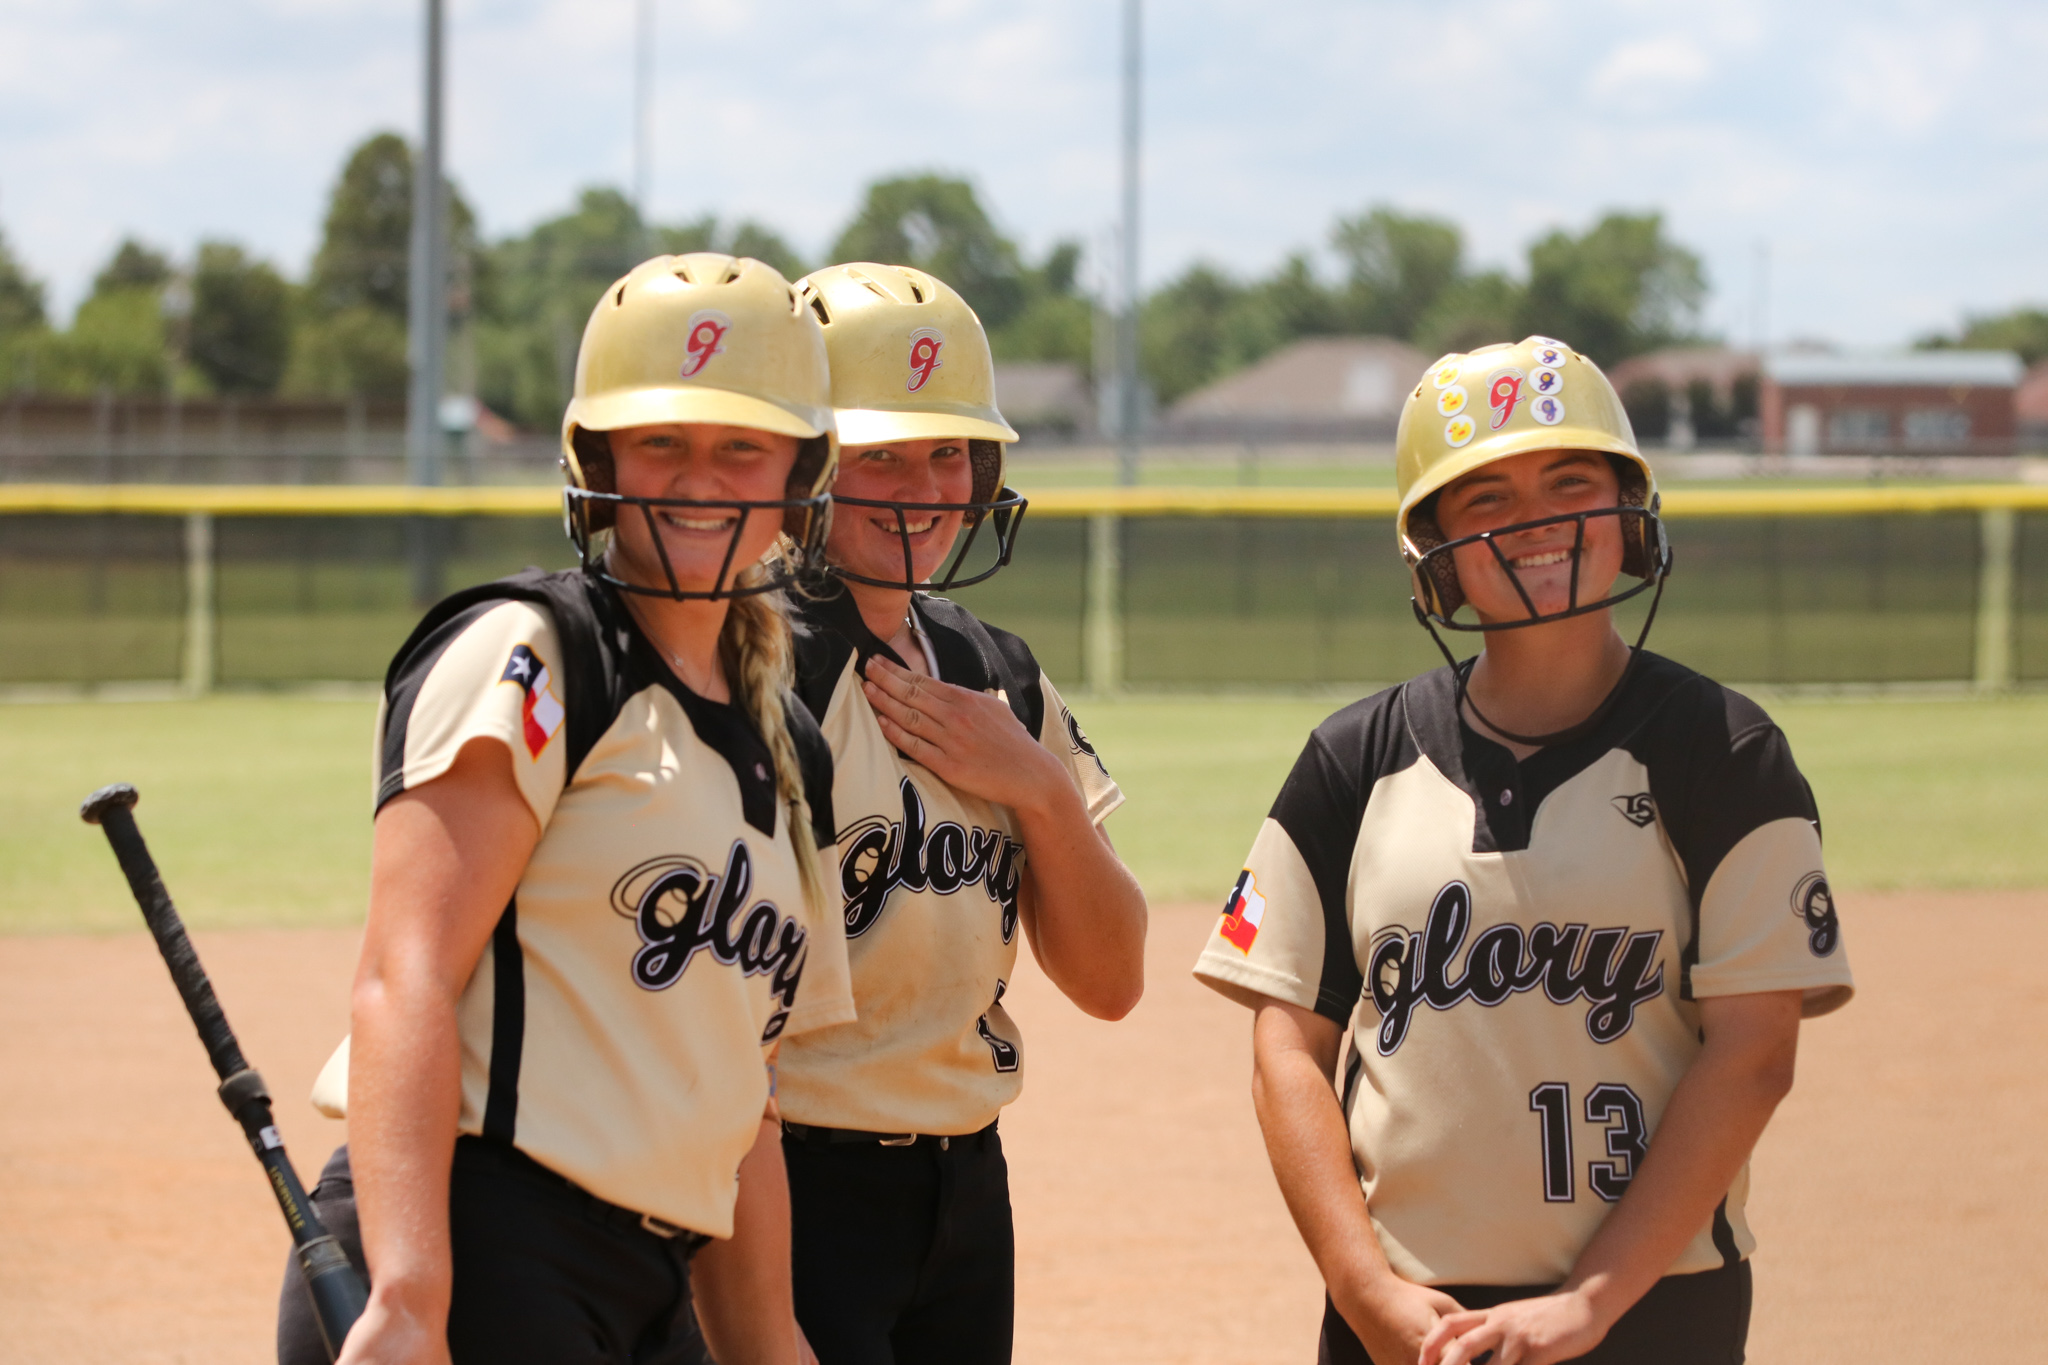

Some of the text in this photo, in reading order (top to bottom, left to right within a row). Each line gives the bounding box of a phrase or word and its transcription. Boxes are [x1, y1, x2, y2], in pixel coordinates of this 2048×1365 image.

[680, 318, 730, 379] g
[905, 335, 944, 393] g
[1488, 374, 1527, 431] g
[840, 776, 1024, 945] glory
[628, 838, 808, 1046] glory
[1370, 880, 1665, 1057] glory
[1529, 1082, 1648, 1203] 13
